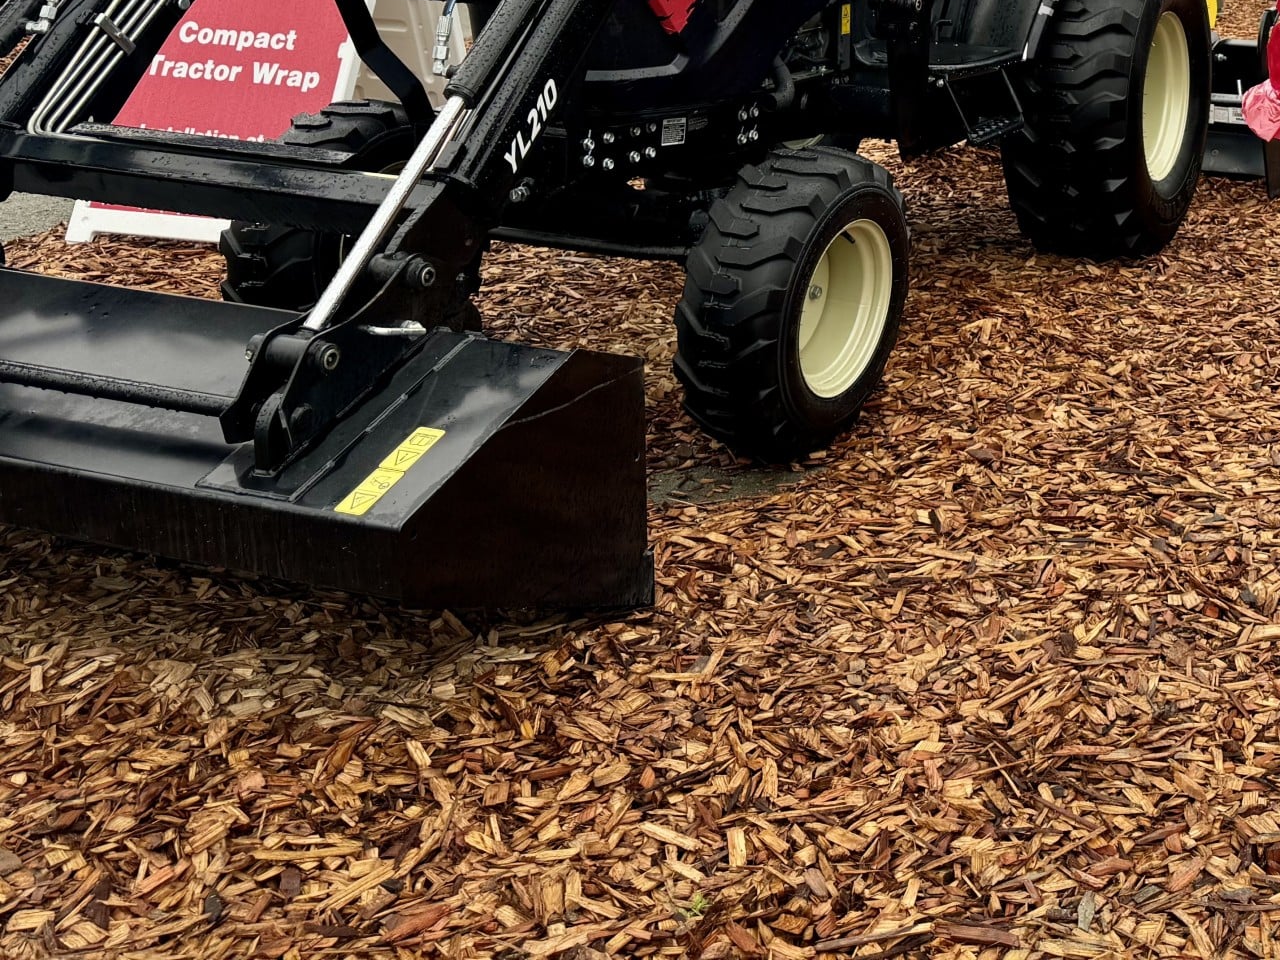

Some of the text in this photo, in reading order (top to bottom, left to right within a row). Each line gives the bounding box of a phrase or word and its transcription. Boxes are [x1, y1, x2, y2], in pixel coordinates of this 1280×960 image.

[179, 21, 297, 51] Compact
[149, 54, 320, 92] Tractor Wrap
[504, 79, 557, 174] YL210
